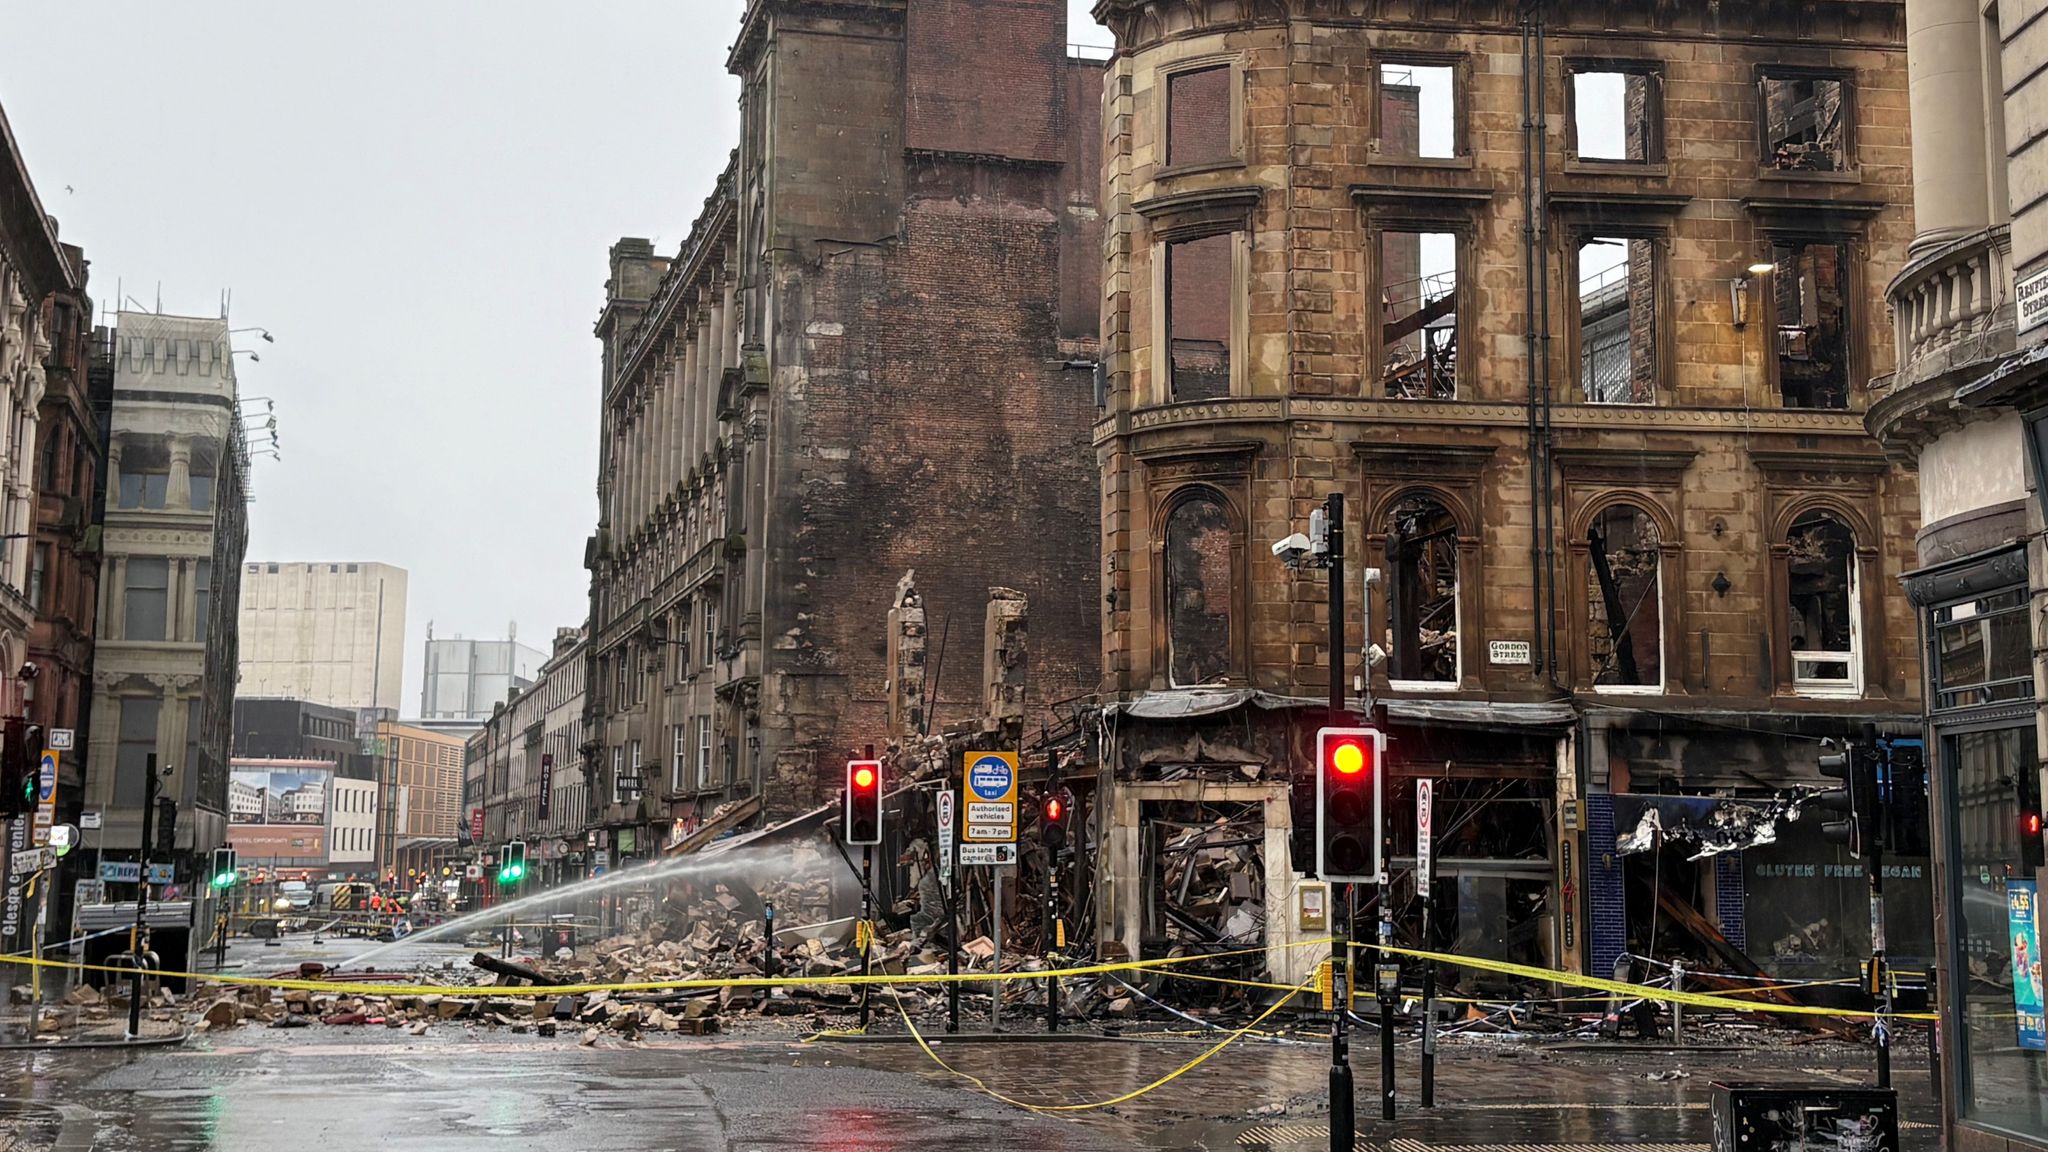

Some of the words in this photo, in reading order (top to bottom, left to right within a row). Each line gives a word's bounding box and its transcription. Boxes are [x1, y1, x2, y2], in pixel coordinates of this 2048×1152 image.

[1491, 642, 1528, 650] GORDON
[620, 779, 638, 787] HOTEL
[1756, 864, 1815, 876] GLUTEN
[1824, 864, 1864, 878] FREE
[1881, 866, 1922, 878] EGAN
